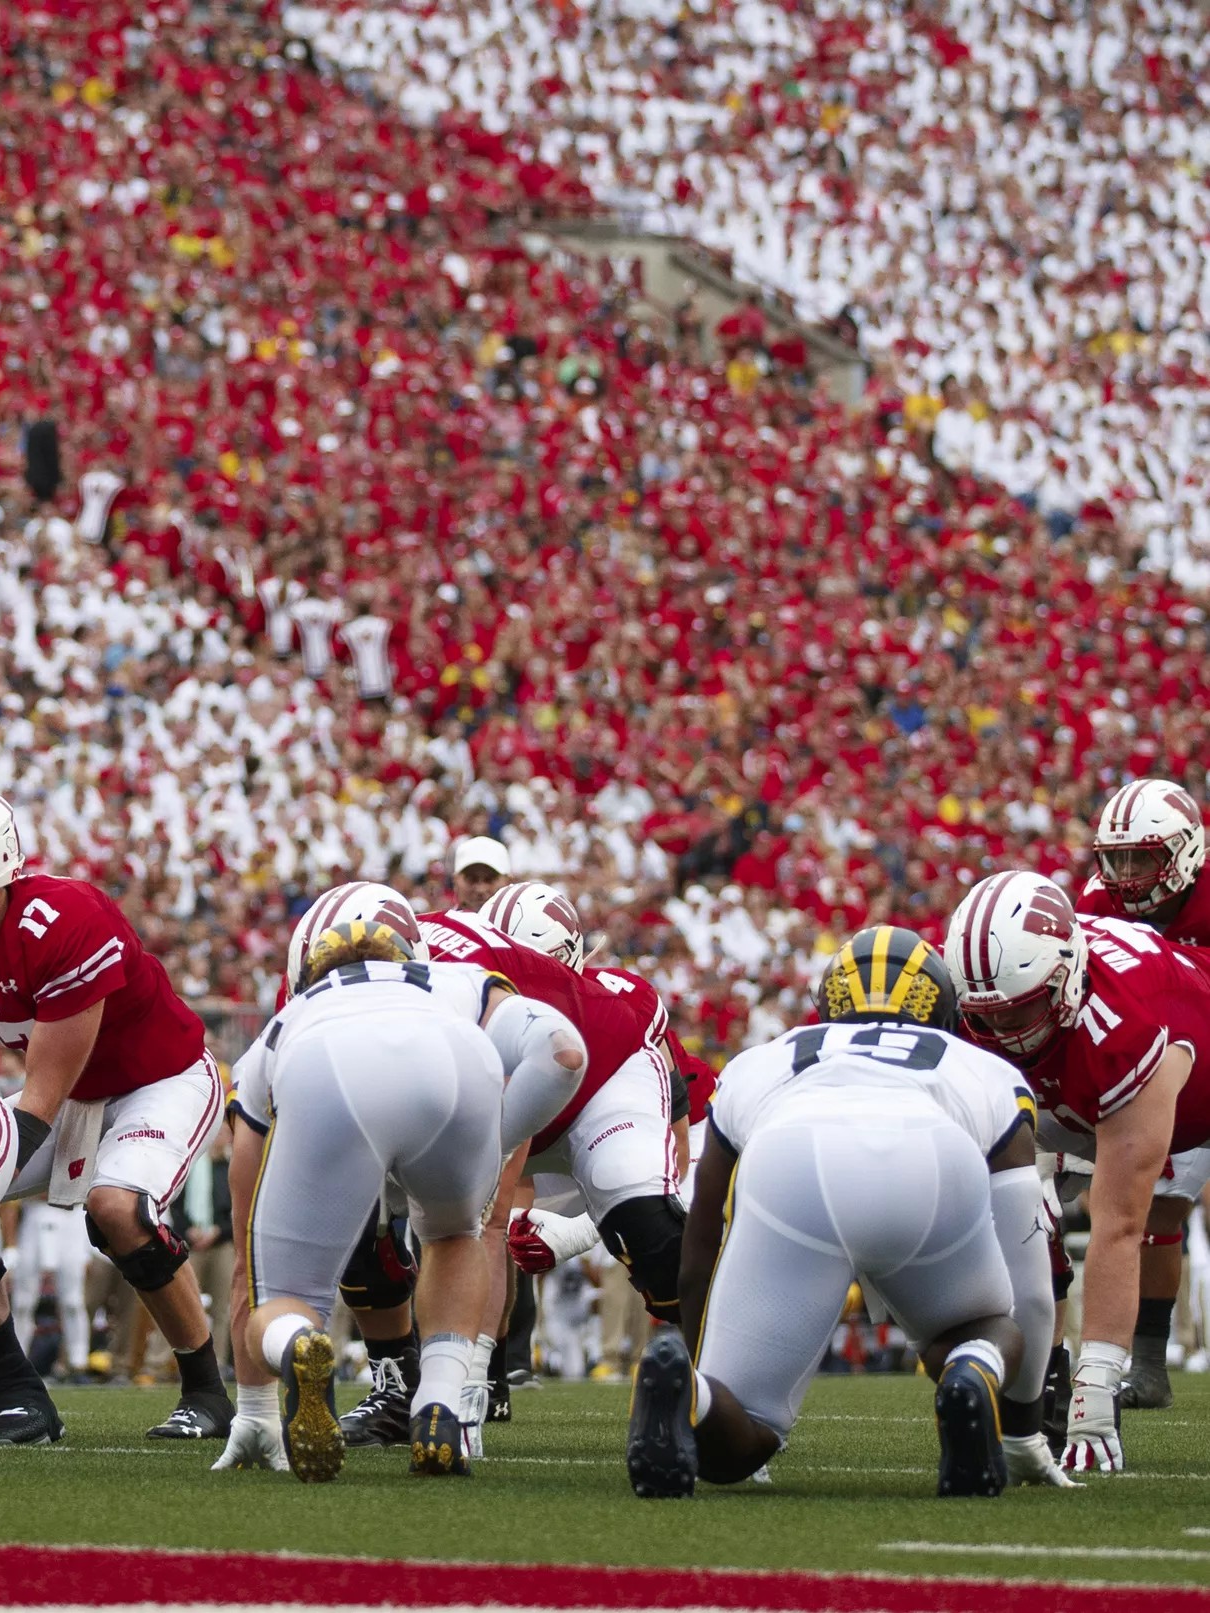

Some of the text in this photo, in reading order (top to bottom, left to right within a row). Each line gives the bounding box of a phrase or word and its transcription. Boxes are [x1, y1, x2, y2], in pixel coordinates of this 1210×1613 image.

[18, 898, 61, 940] 17
[1022, 886, 1077, 943] W
[1075, 992, 1123, 1047] 71
[117, 1129, 165, 1142] WISCONSIN
[587, 1121, 635, 1152] WISCONSIN
